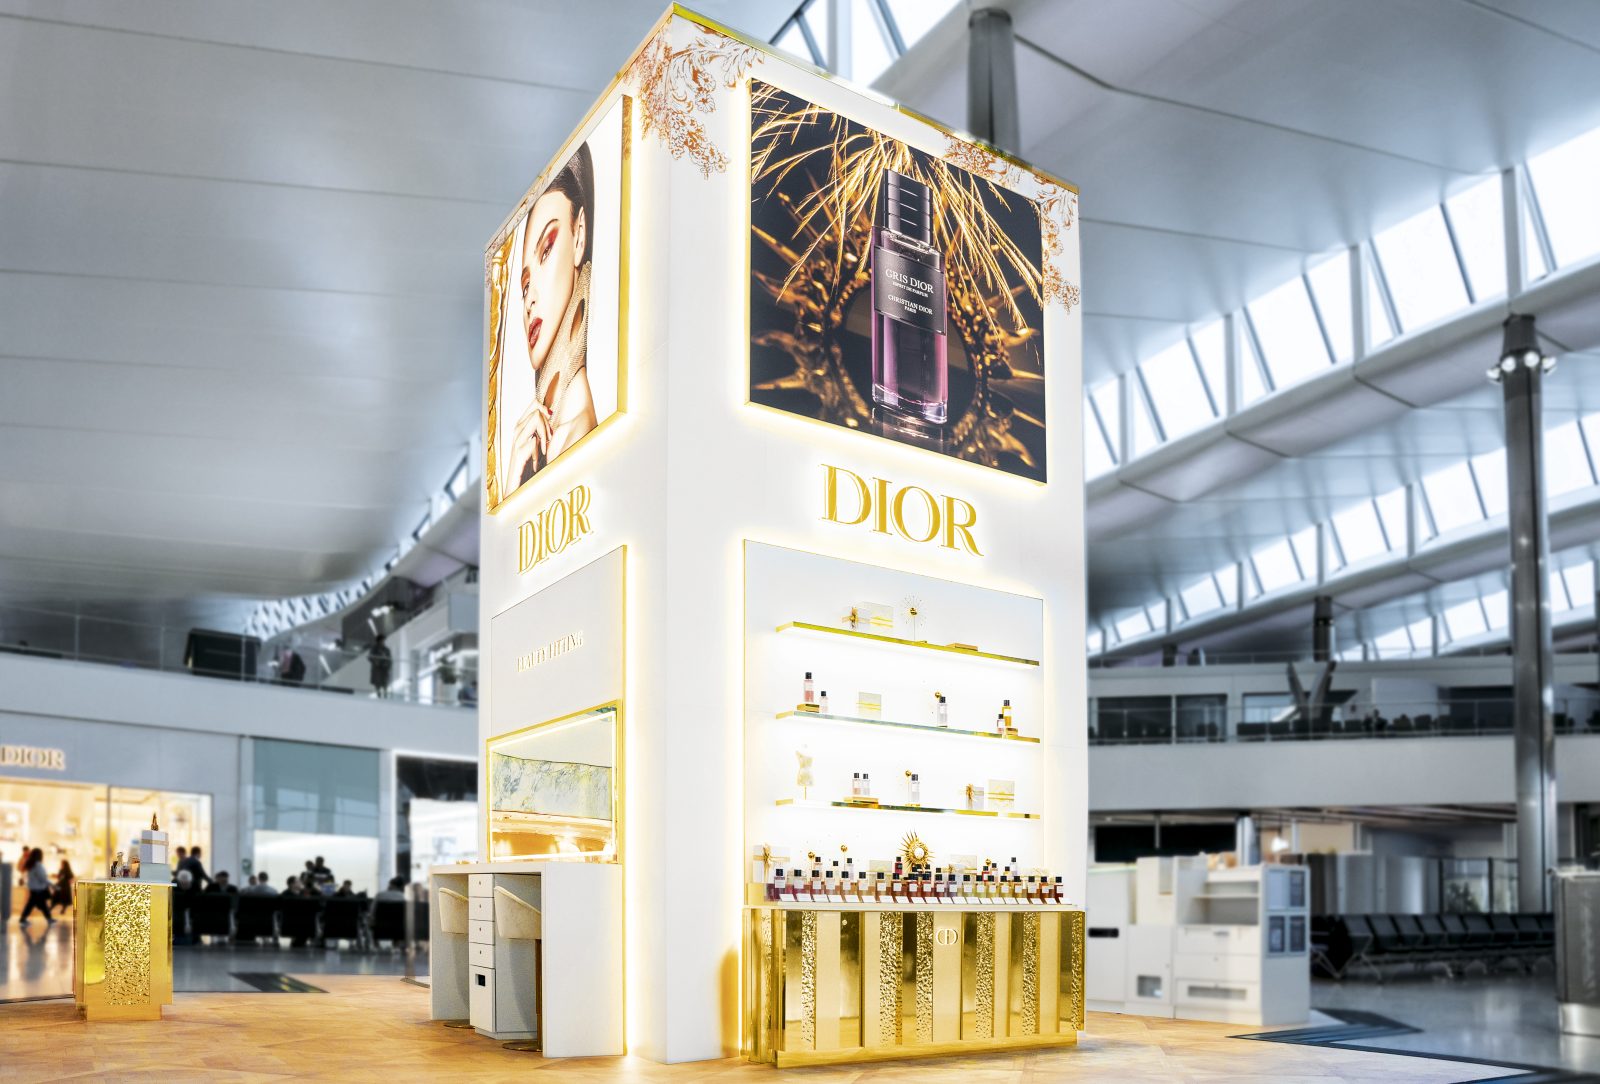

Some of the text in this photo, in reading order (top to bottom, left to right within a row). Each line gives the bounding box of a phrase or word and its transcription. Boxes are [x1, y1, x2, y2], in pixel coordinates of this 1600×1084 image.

[885, 269, 934, 294] GRIS DIOR
[887, 294, 933, 315] CHRISTIAN DIOR
[904, 305, 917, 314] PARIS
[818, 463, 985, 557] DIOR
[517, 484, 594, 575] DIOR
[0, 745, 66, 770] DIOR
